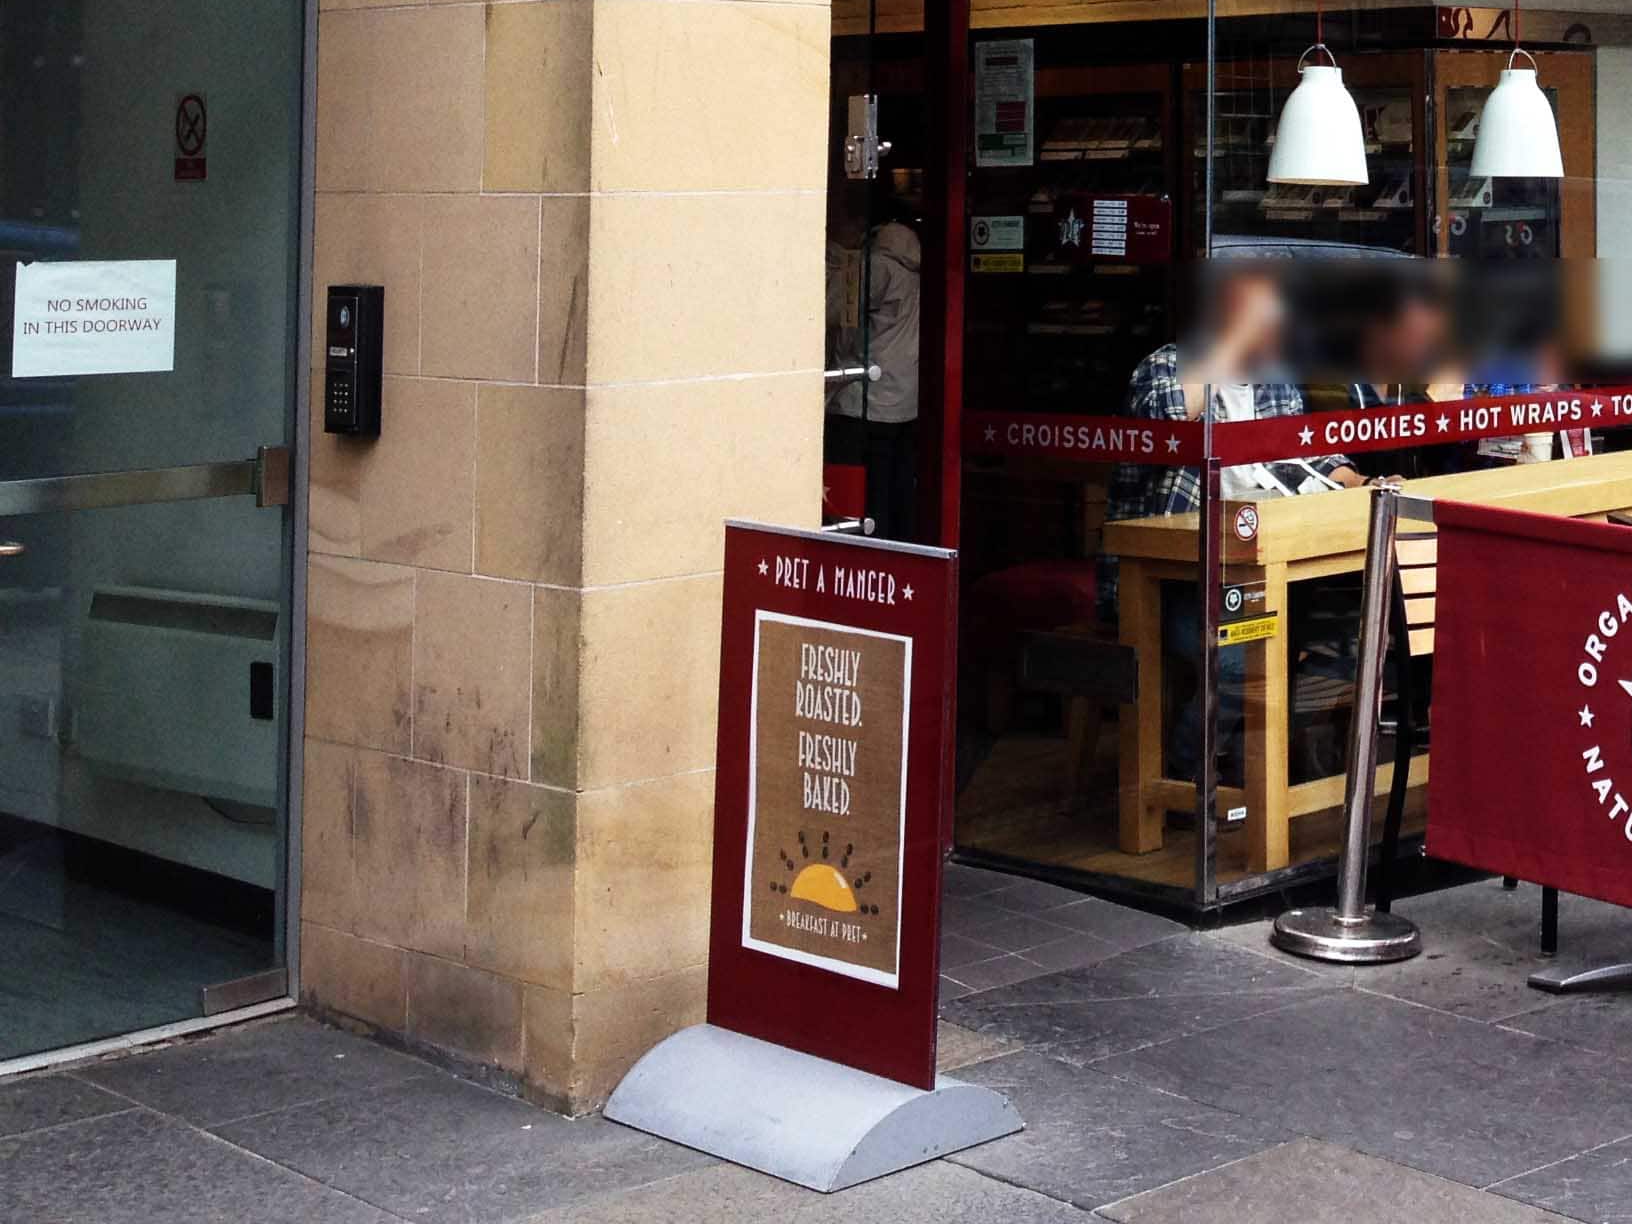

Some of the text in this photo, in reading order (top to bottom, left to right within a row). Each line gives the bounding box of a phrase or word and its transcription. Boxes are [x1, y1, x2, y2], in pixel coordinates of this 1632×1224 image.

[23, 319, 161, 335] IN THIS DOORWAY
[47, 297, 148, 313] NO SMOKING
[1007, 423, 1155, 454] CROISSANTS
[1324, 413, 1426, 446] COOKIES
[1459, 405, 1502, 433] HOT
[1509, 397, 1583, 428] WRAPS
[775, 555, 896, 605] PRET A MANGER
[801, 643, 861, 687] FRESHLY
[795, 680, 862, 727] ROASTED.
[799, 731, 857, 777] FRESHLY
[804, 771, 850, 816] BAKED.
[785, 909, 861, 944] BREAKFAST AT PRET
